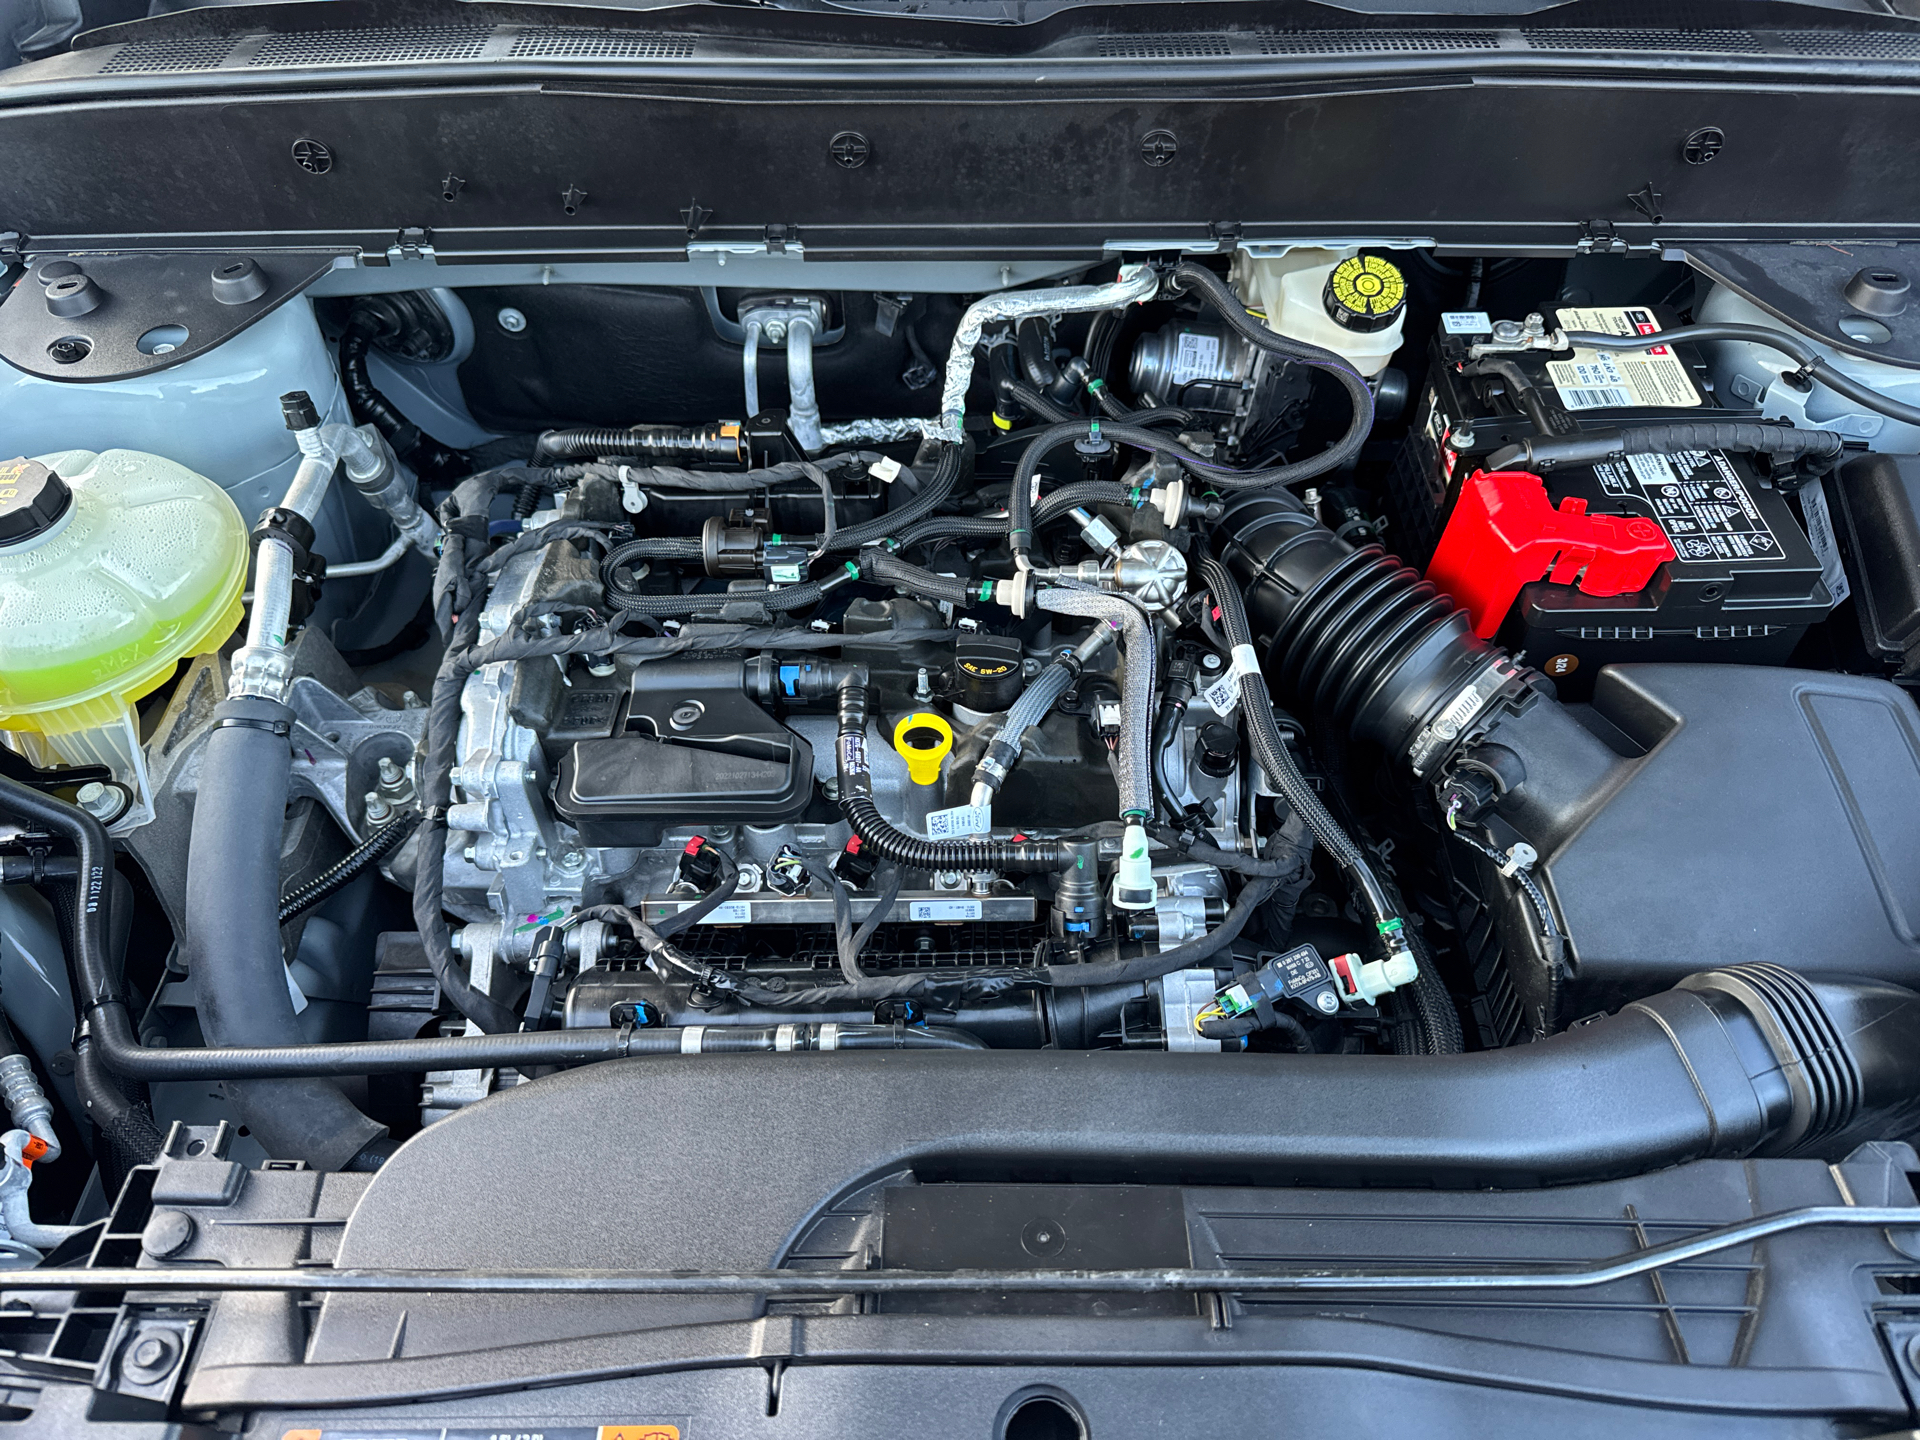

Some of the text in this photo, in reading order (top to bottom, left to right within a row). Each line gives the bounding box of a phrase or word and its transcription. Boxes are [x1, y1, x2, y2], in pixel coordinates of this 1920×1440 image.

[1577, 366, 1587, 374] 120
[1590, 364, 1601, 374] 760
[1717, 460, 1758, 519] DANGER/POISON
[100, 643, 150, 673] MAX
[964, 662, 1007, 675] SAE 5W-20
